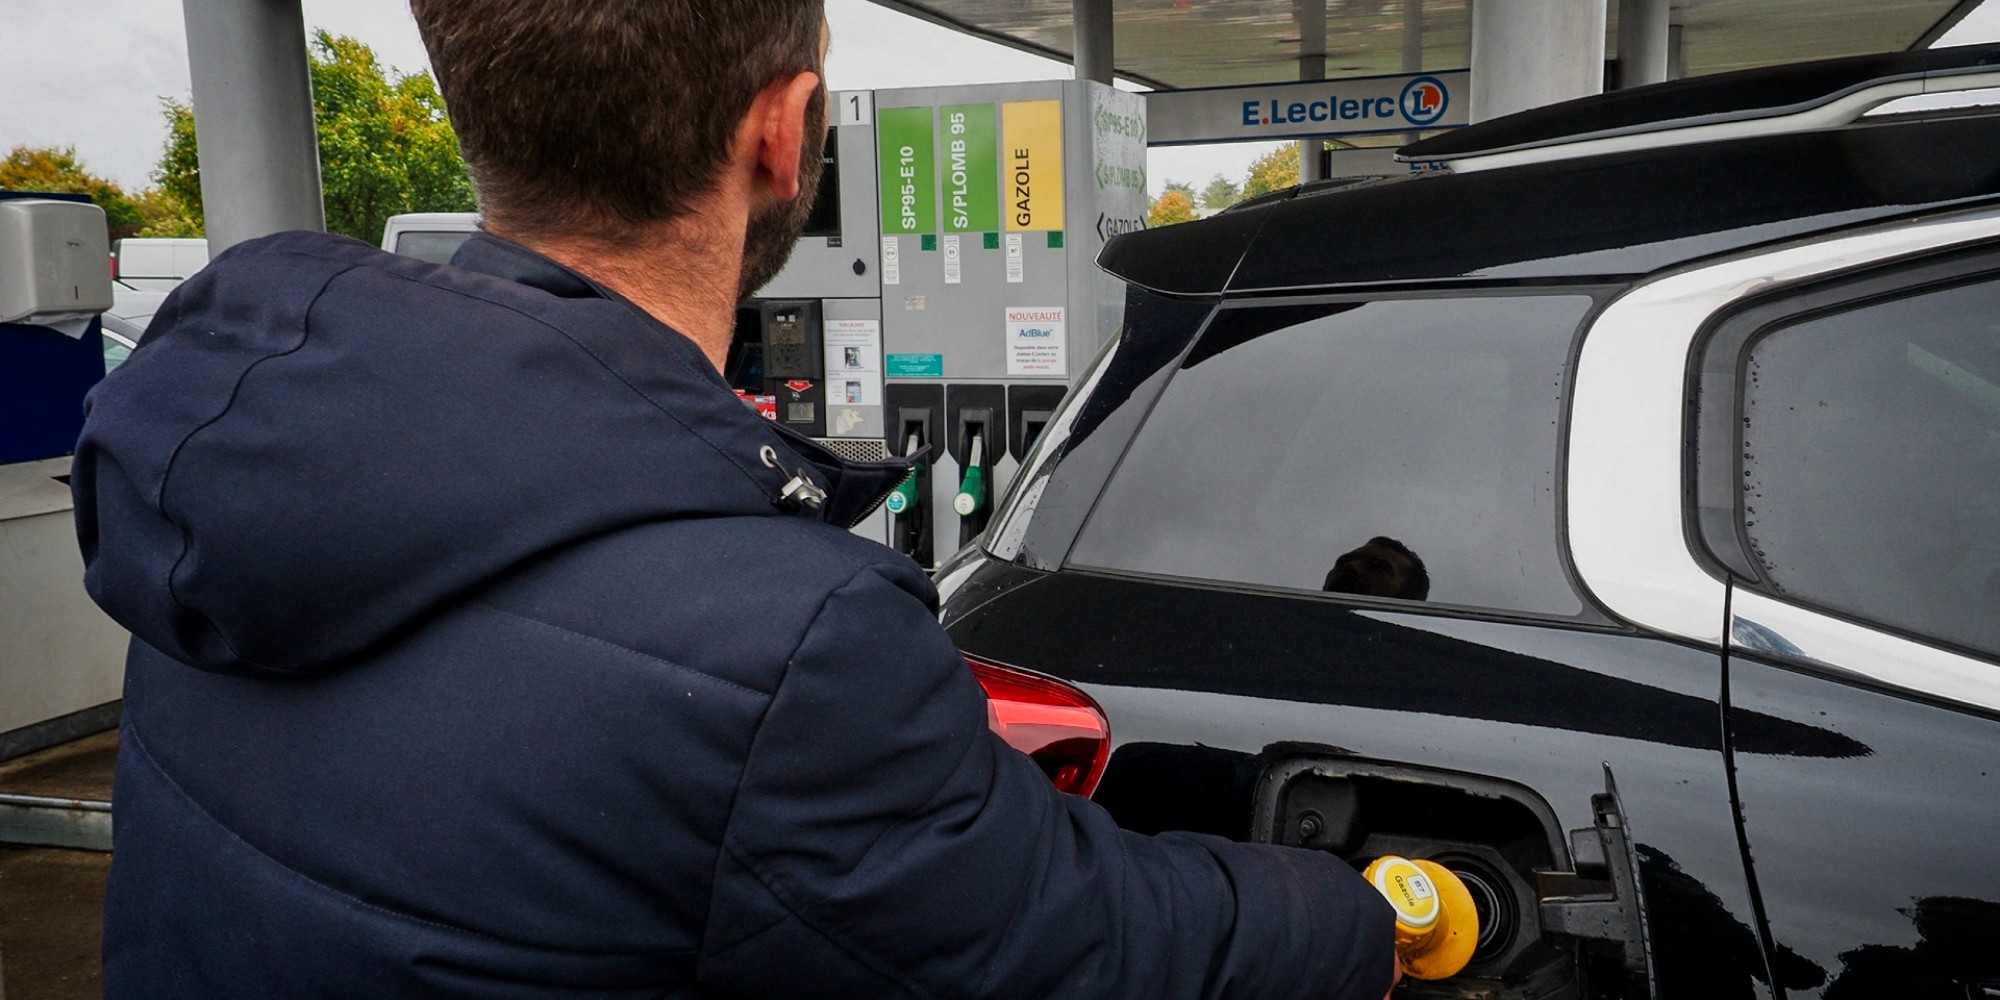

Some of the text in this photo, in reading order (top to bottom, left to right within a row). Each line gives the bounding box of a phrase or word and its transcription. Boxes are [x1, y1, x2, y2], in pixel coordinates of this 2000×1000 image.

[850, 95, 860, 121] 1
[1242, 96, 1395, 126] E.Leclerc
[950, 112, 965, 135] 95
[900, 146, 916, 229] SP95-E10
[951, 139, 968, 228] S/PLOMB
[1015, 148, 1031, 227] GAZOLE
[1009, 310, 1062, 321] NOUVEAUTÉ
[1395, 875, 1415, 907] Gazole
[1414, 880, 1425, 893] B7
